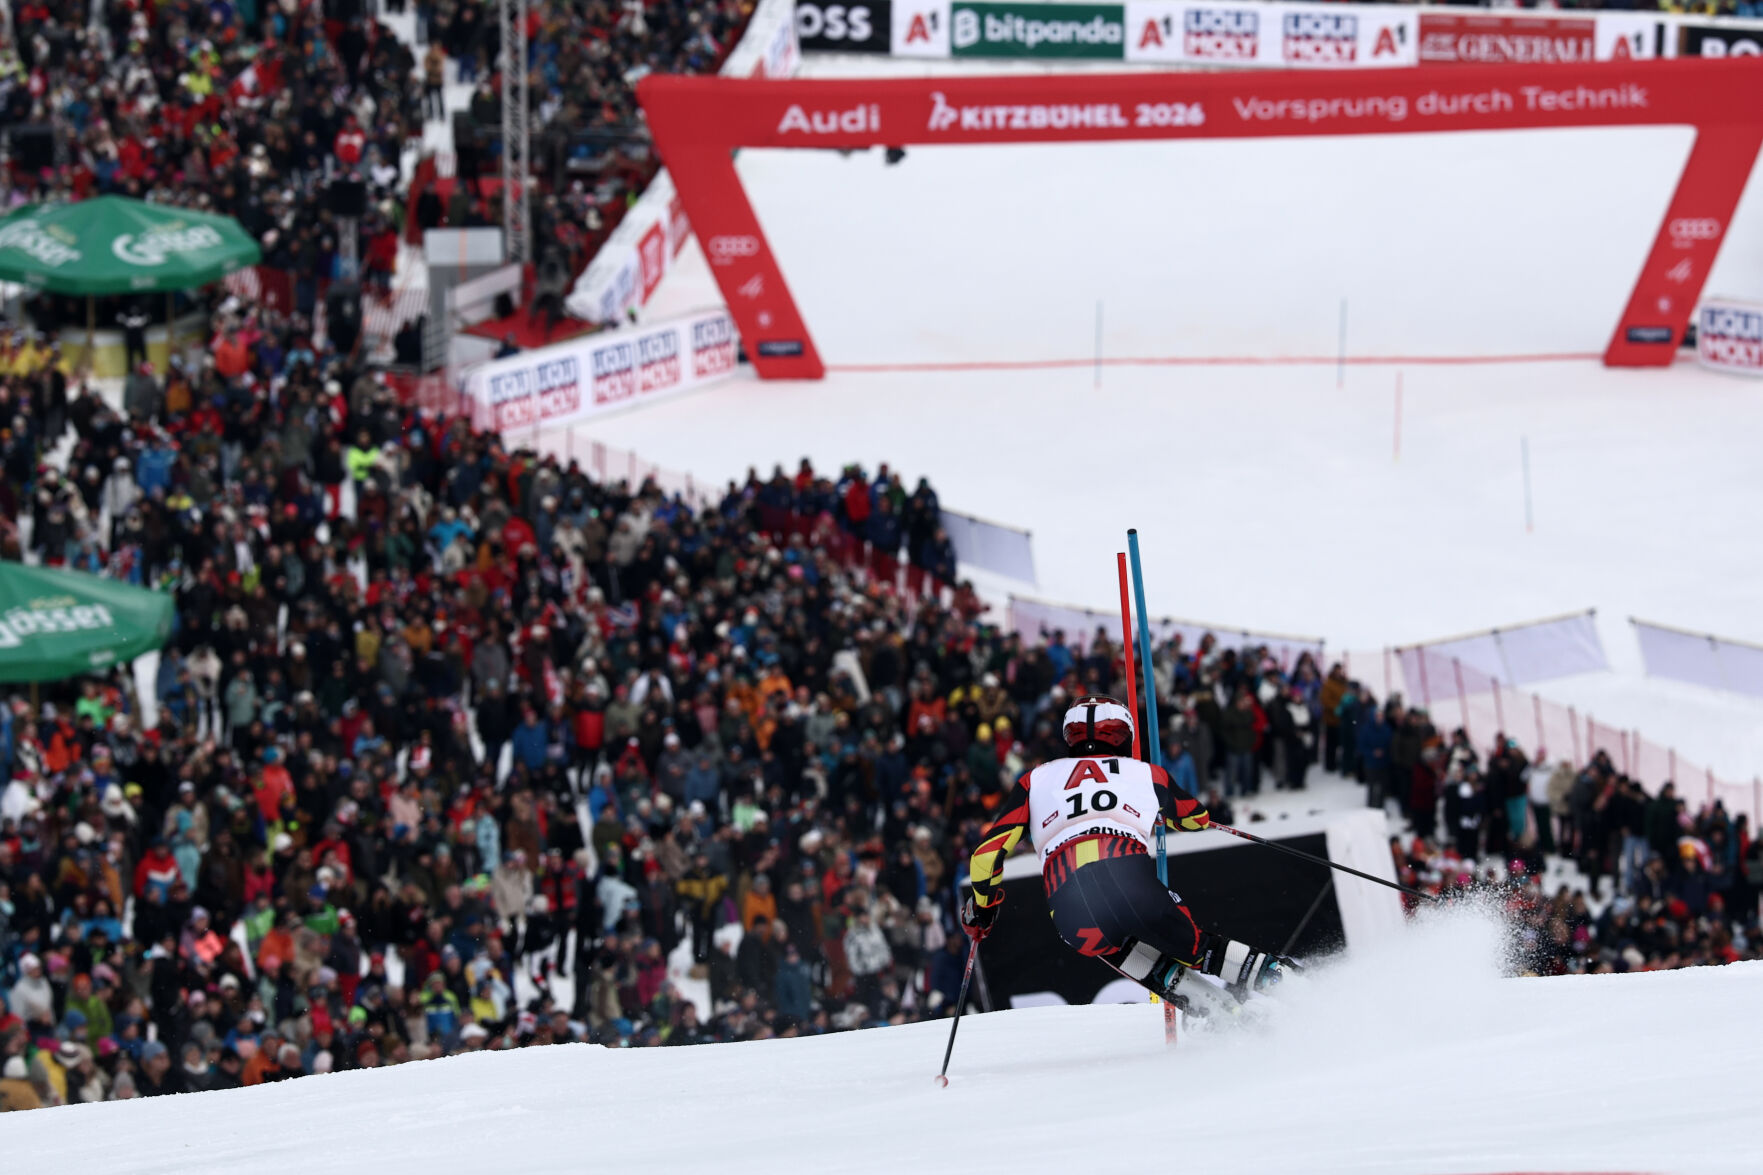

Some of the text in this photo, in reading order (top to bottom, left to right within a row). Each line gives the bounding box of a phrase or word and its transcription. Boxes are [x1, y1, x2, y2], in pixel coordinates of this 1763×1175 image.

[984, 12, 1122, 49] bitpanda
[1185, 10, 1258, 33] LIQUI
[1284, 14, 1357, 38] LIQUI
[1184, 33, 1257, 58] MOLY
[1283, 37, 1356, 62] MOLY
[1457, 34, 1592, 62] GENERALI
[1135, 101, 1205, 127] 2026
[1232, 82, 1648, 123] Vorsprung durch Technik
[777, 103, 880, 134] Audi
[1064, 759, 1120, 790] A1
[1066, 790, 1118, 820] 10
